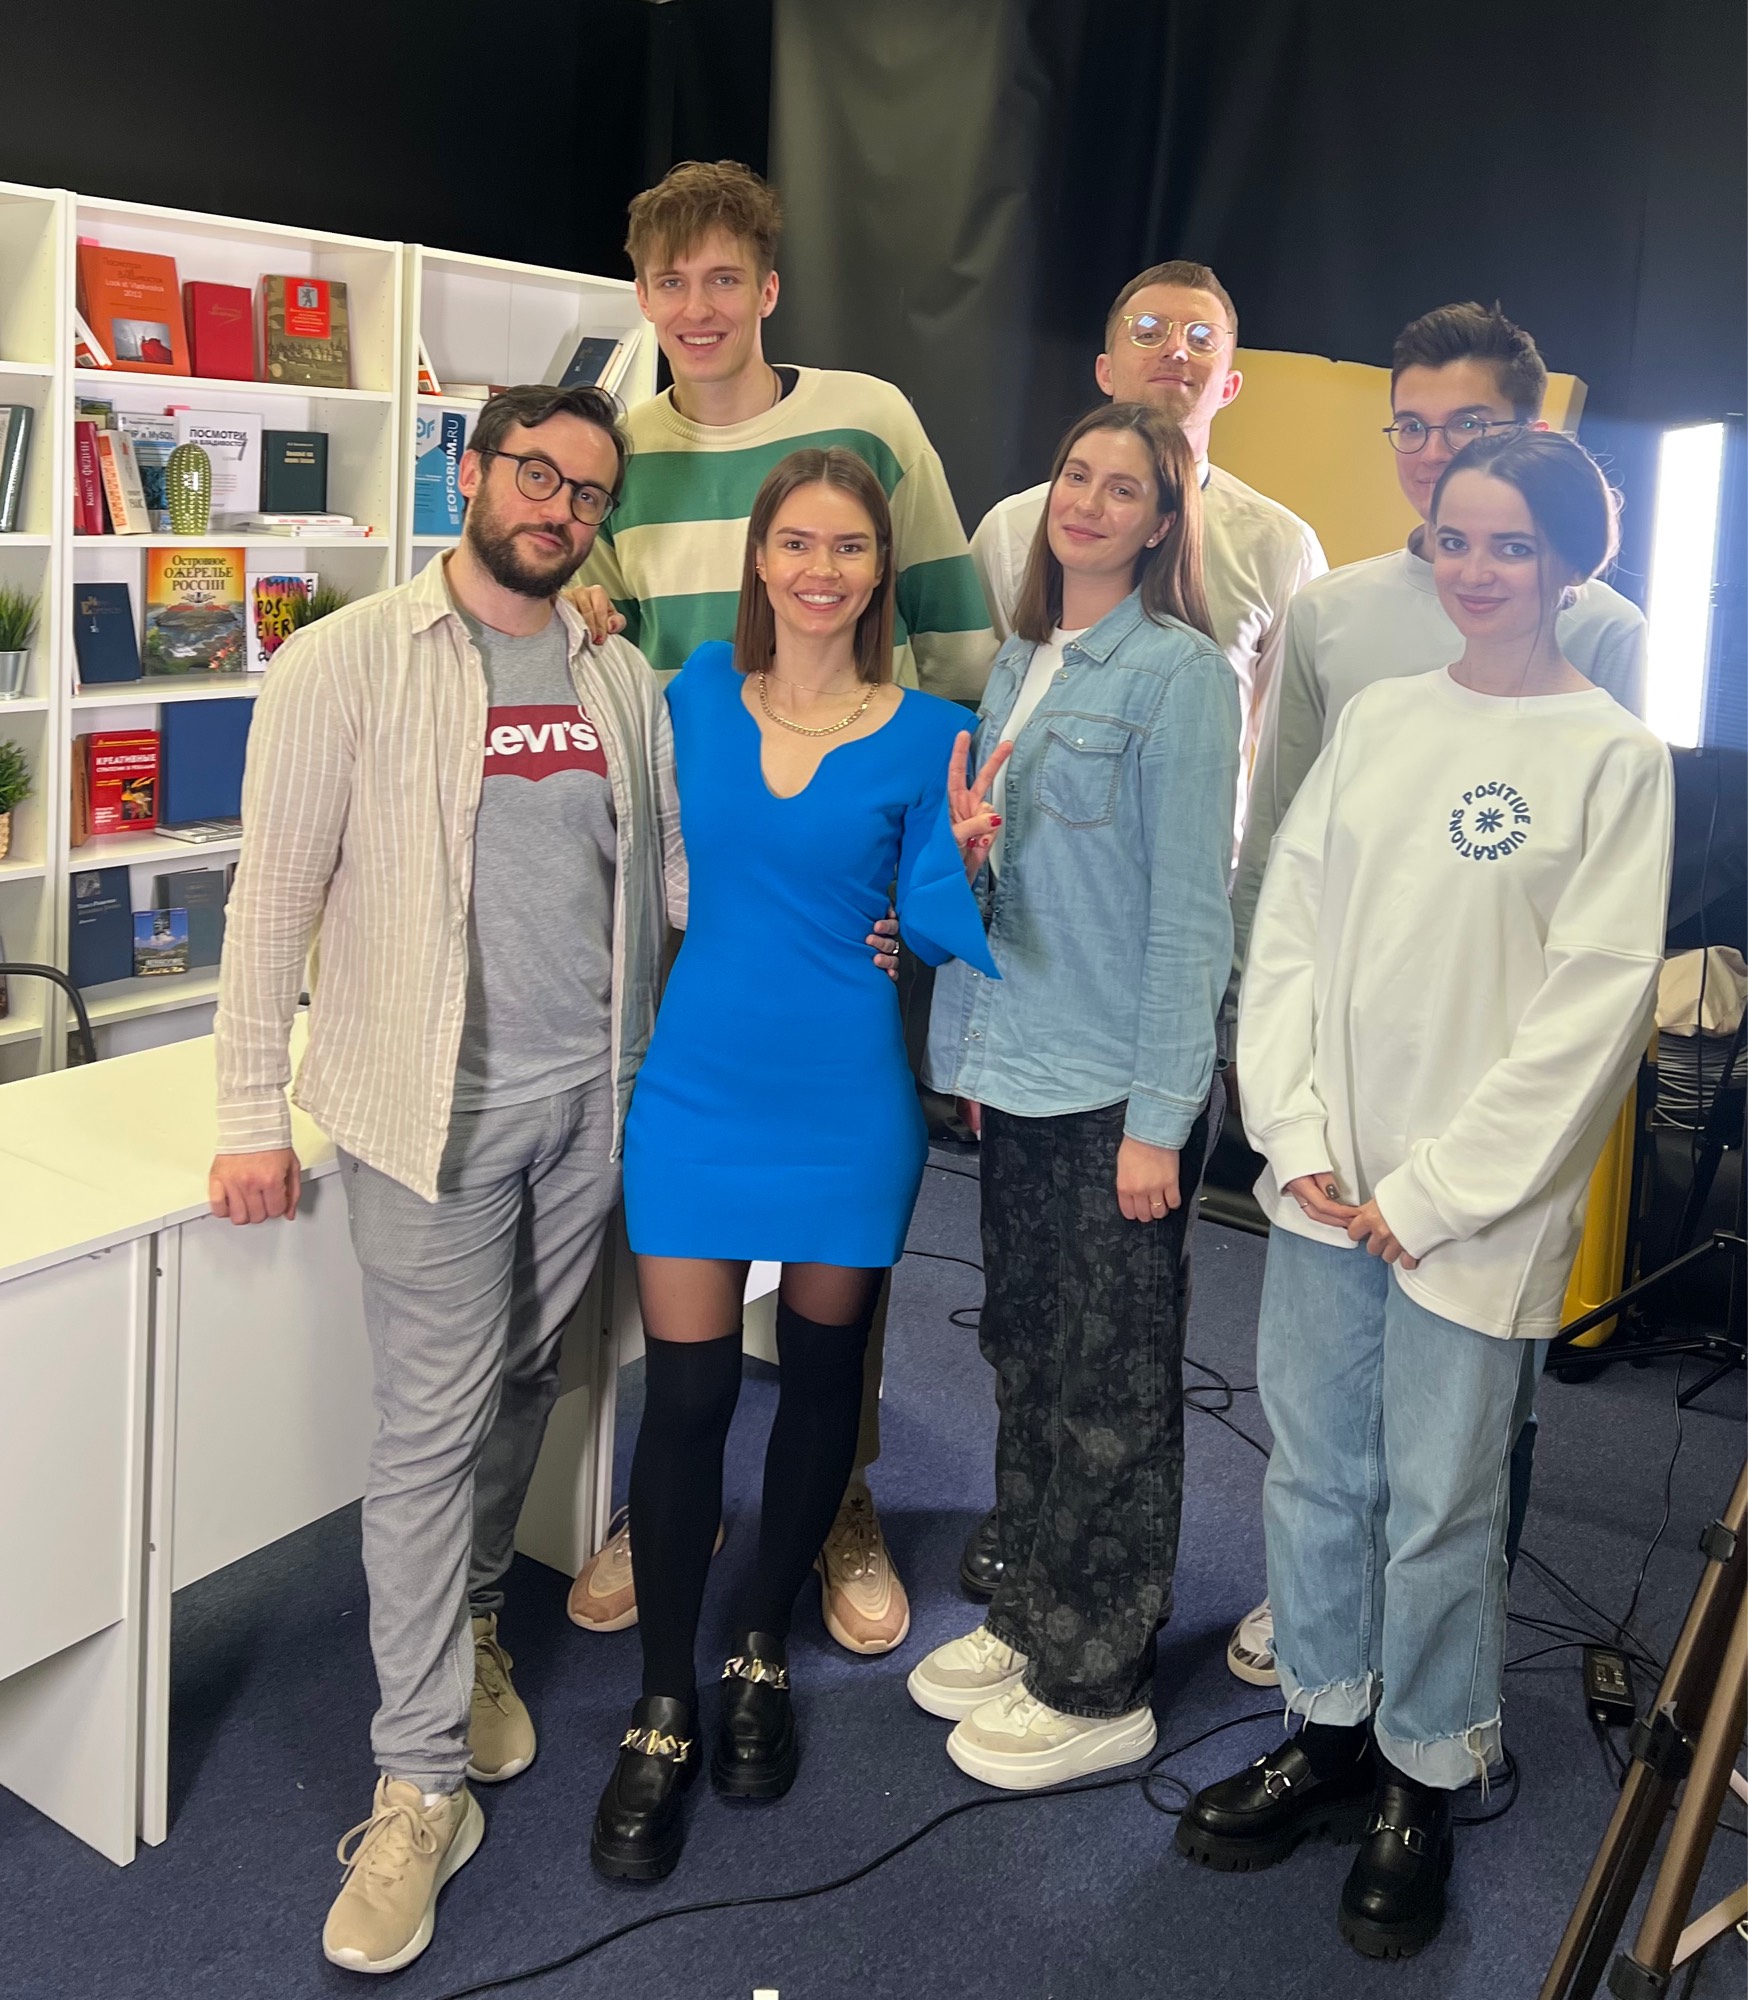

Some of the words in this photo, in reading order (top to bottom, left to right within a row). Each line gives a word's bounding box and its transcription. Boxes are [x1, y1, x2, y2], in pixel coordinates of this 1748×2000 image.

[190, 429, 247, 440] ПОСМОТРИ
[164, 567, 233, 578] ОЖЕРЕЛЬЕ
[172, 579, 225, 591] РОССИИ
[1462, 781, 1531, 824] POSITIVE
[1449, 808, 1527, 861] VIBRATIONS
